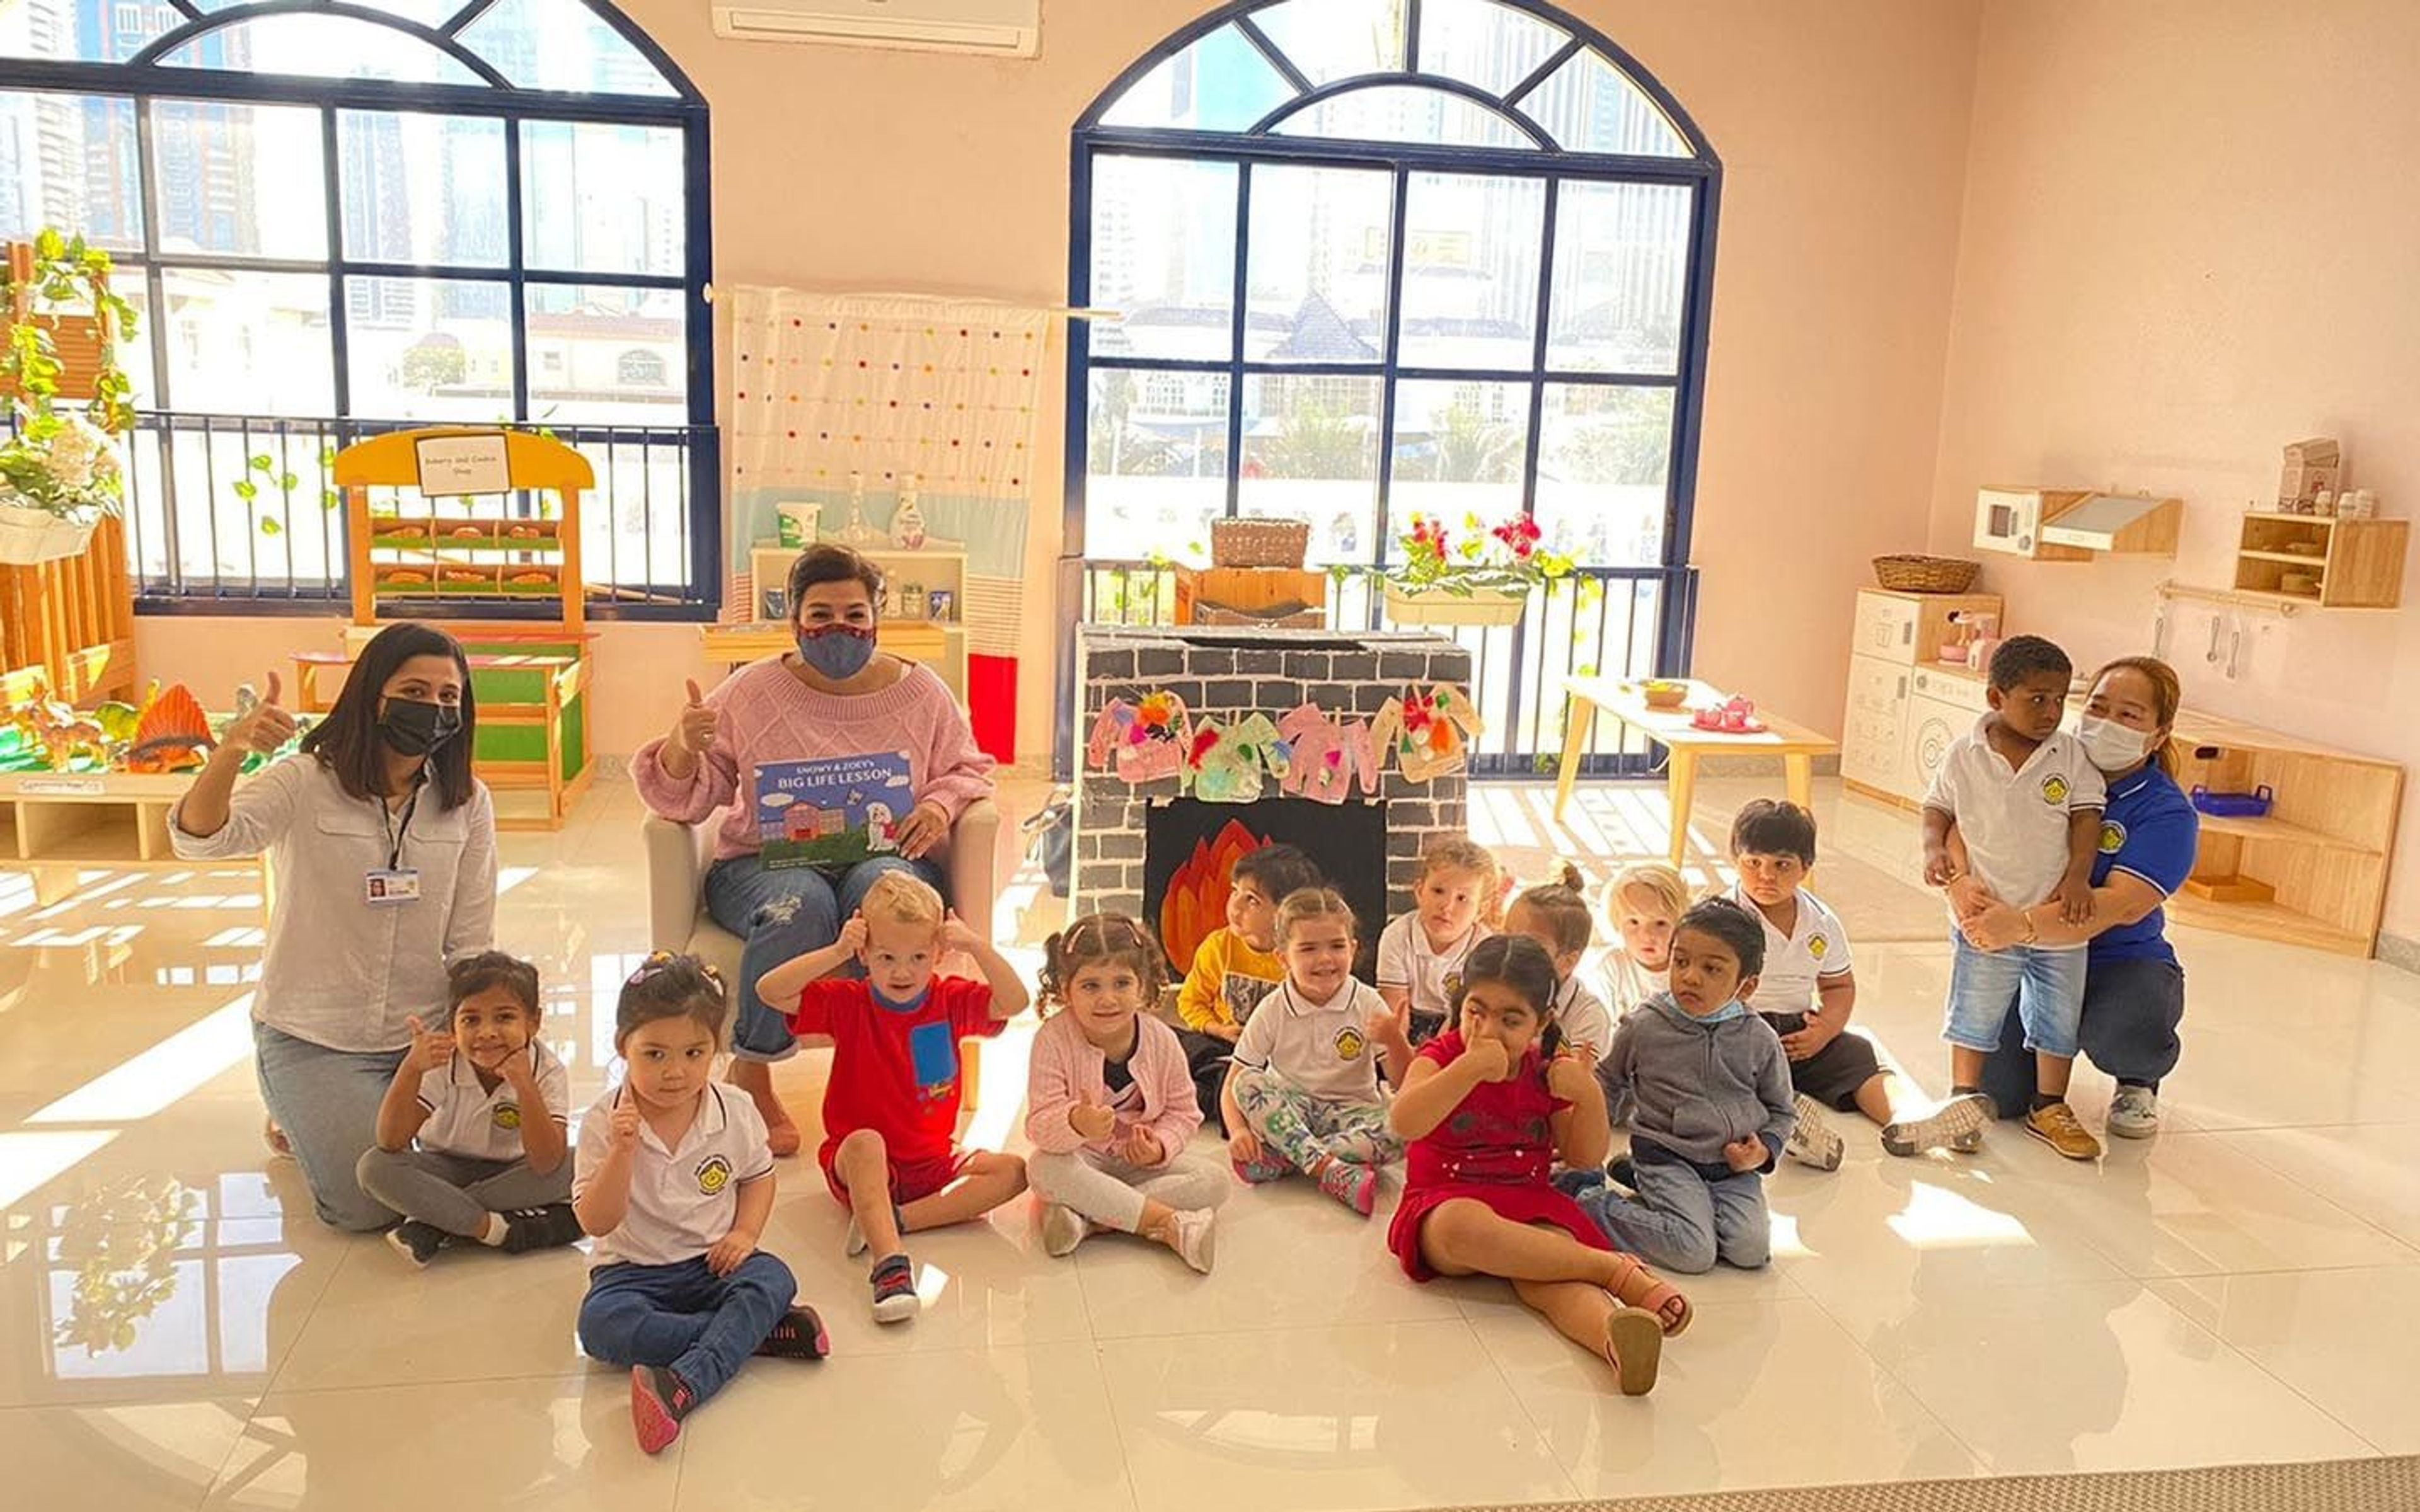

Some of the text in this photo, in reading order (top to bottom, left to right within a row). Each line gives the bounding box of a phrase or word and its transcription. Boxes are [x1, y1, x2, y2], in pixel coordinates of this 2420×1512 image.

[833, 762, 841, 771] &
[778, 767, 892, 789] BIG LIFE LESSON
